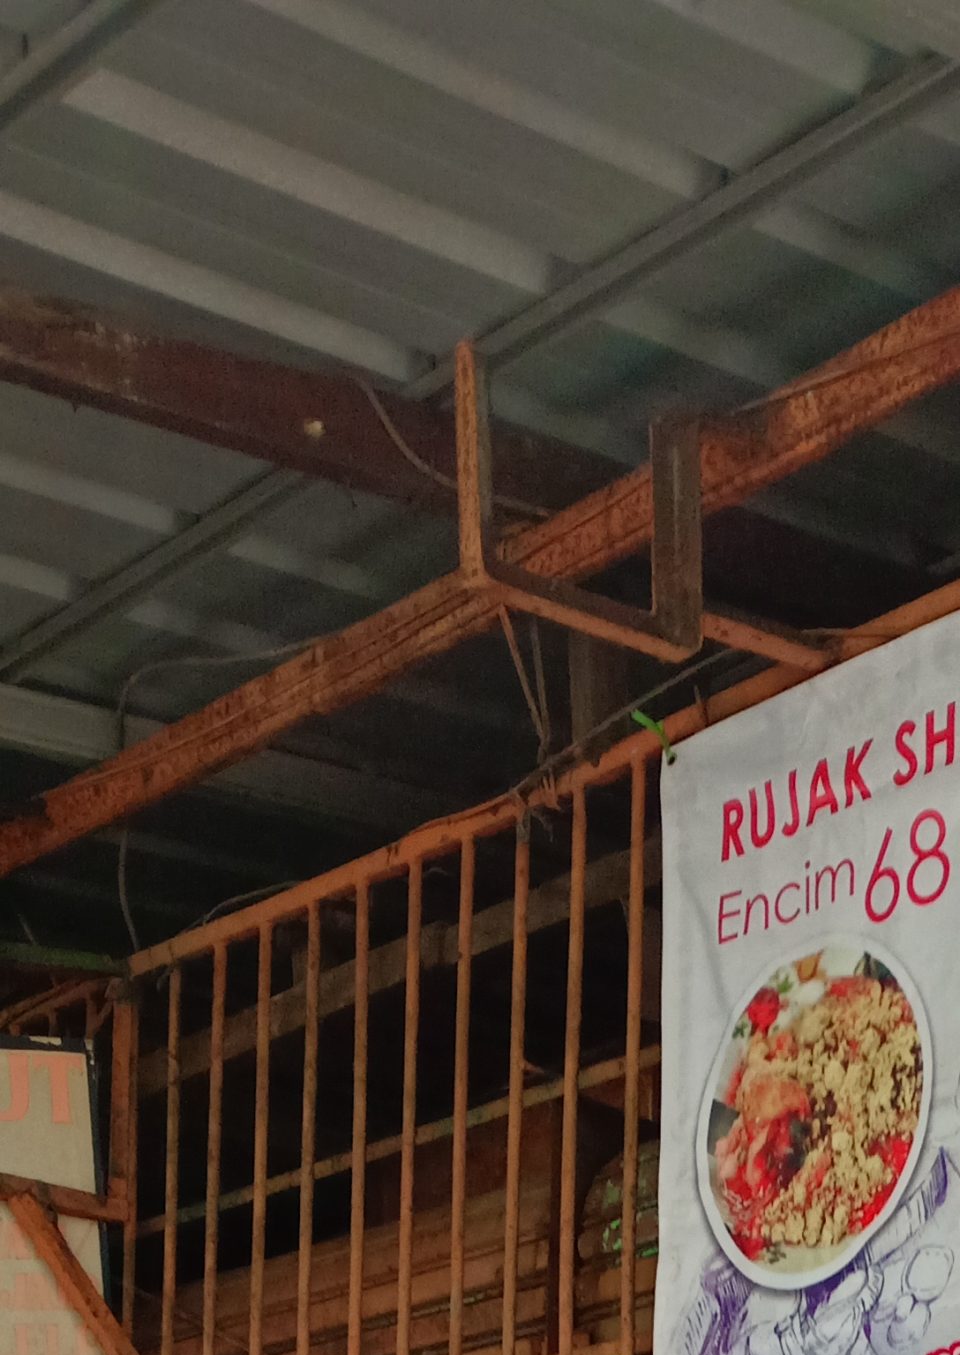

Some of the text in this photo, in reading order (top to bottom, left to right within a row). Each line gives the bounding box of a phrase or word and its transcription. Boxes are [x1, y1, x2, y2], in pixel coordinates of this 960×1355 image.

[721, 738, 874, 862] RUJAK
[718, 809, 950, 944] Encim 68
